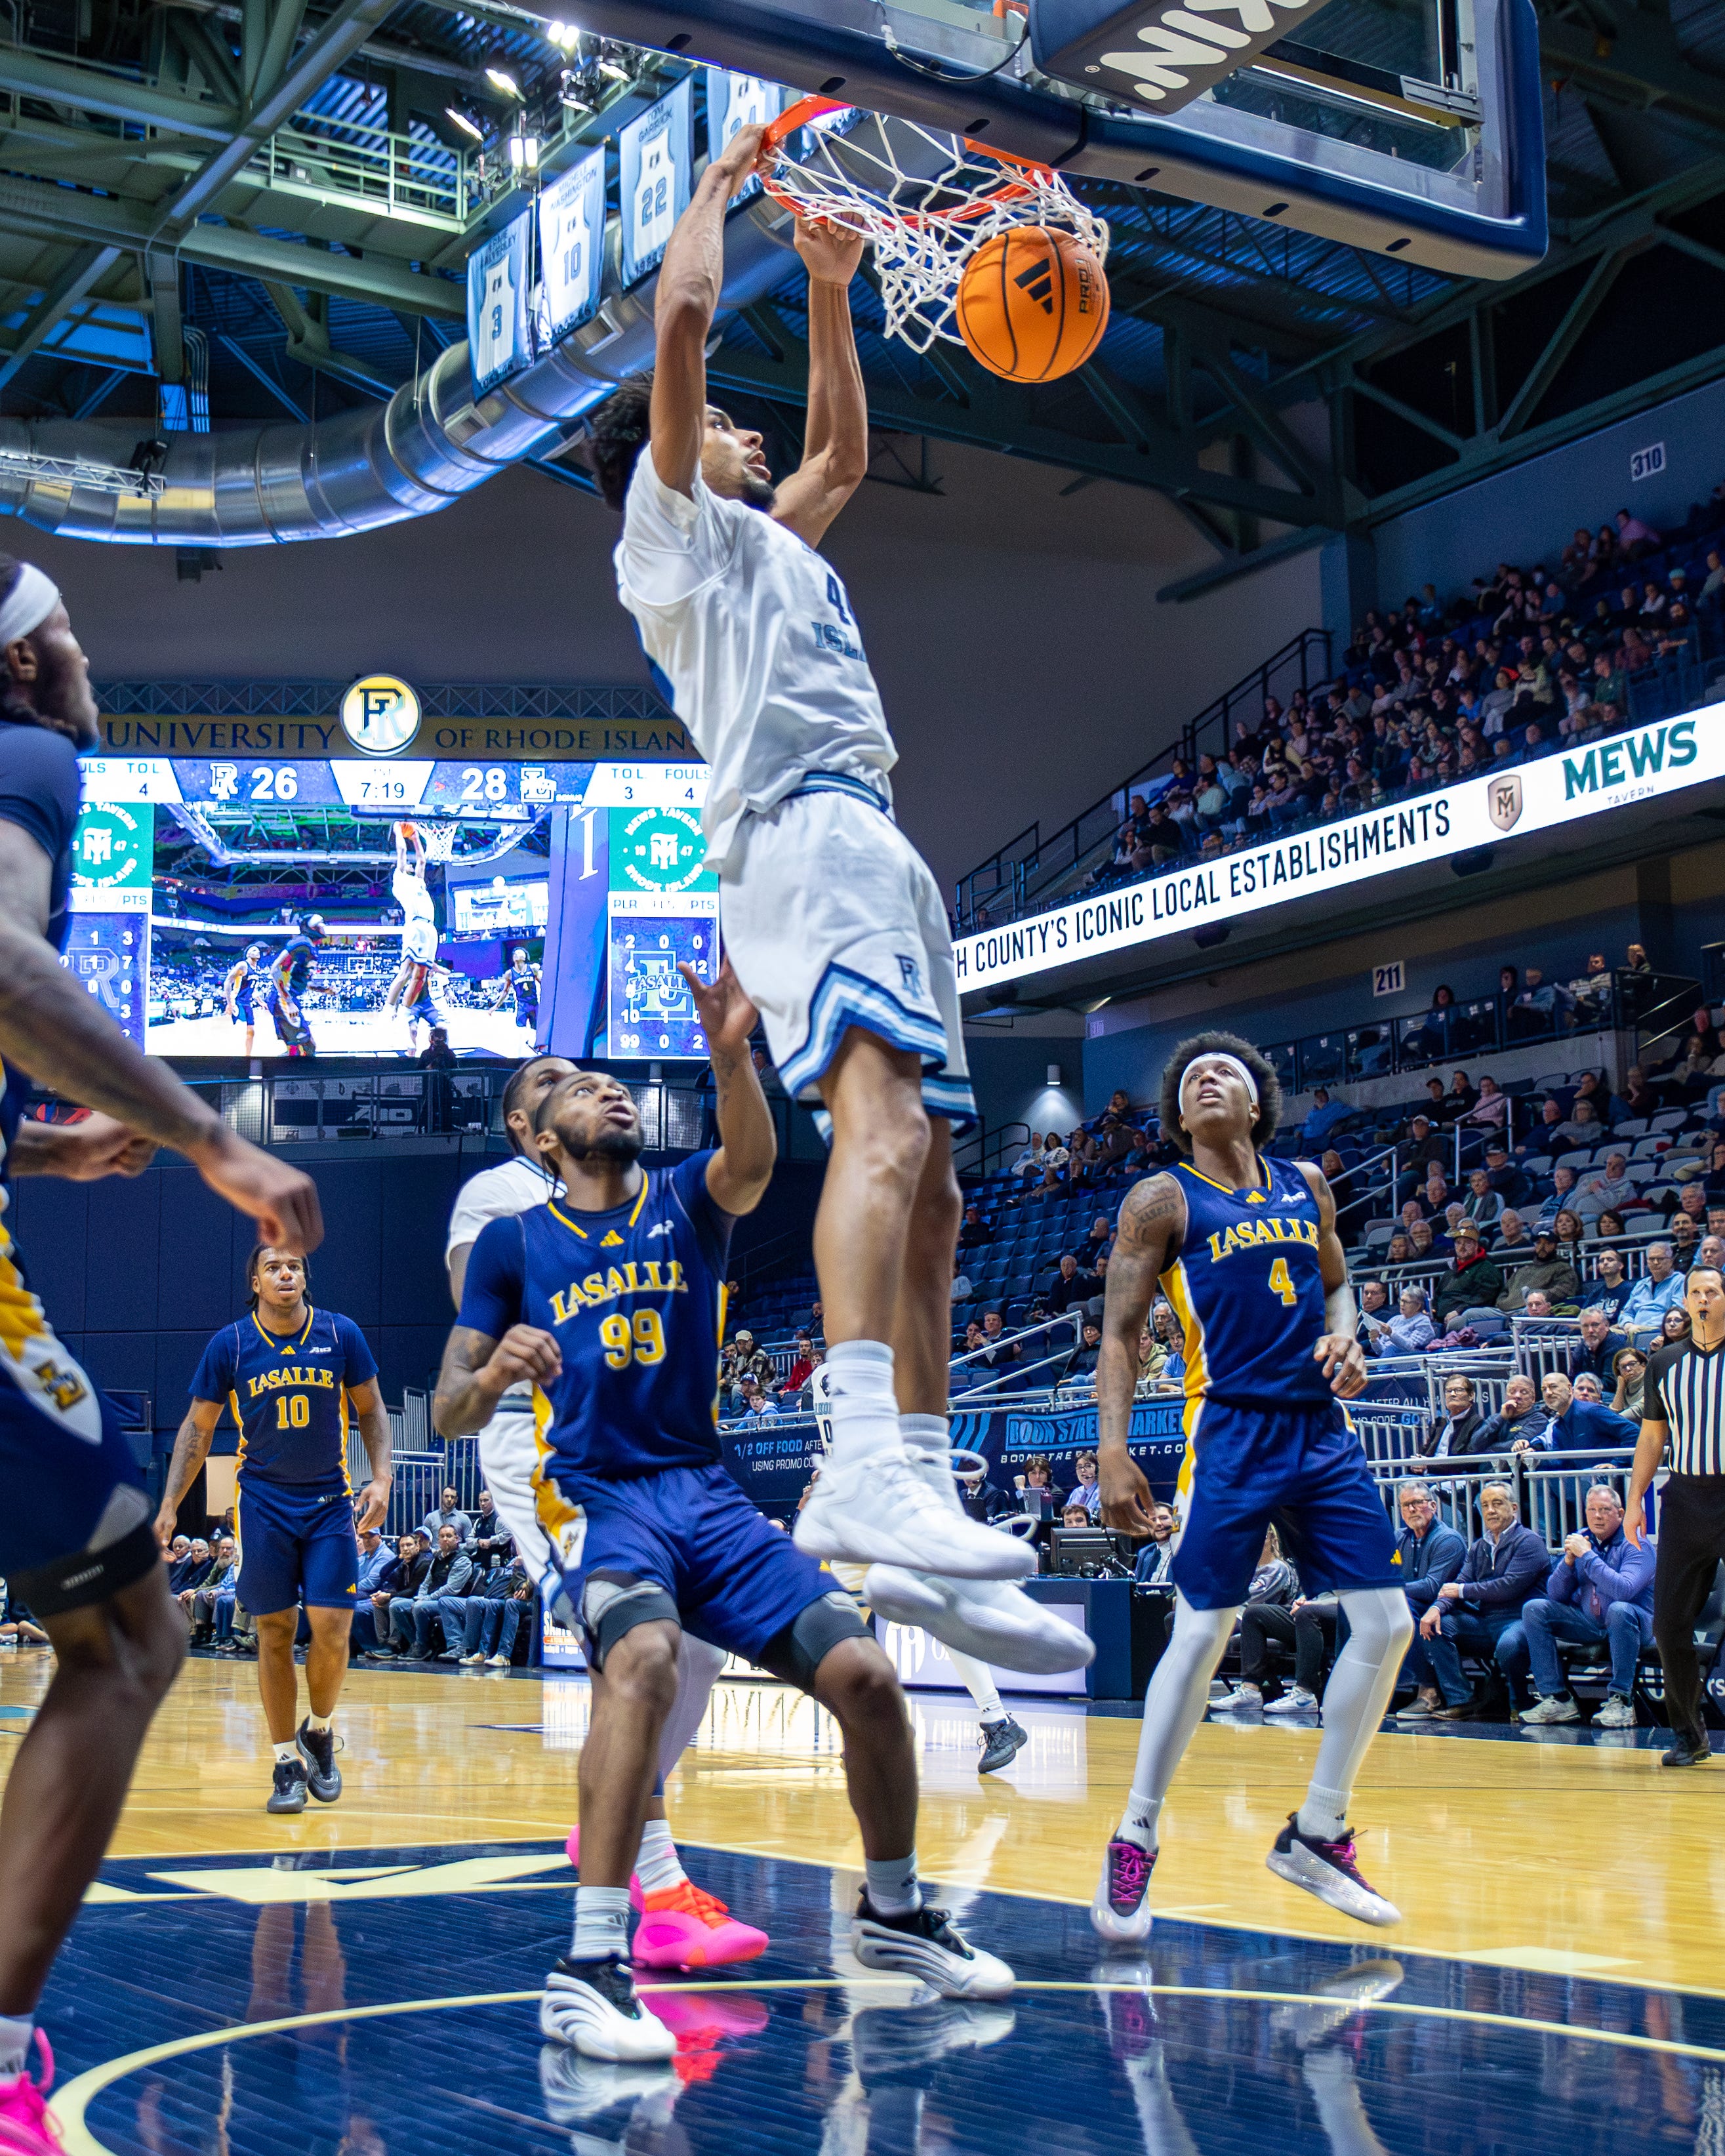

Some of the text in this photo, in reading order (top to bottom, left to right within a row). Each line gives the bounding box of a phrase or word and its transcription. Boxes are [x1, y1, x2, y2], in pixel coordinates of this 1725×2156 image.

[559, 164, 587, 192] MICHELE
[641, 176, 667, 228] 22
[564, 242, 582, 287] 10
[492, 304, 502, 341] 3
[1632, 447, 1662, 477] 310
[106, 722, 336, 750] UNIVERSITY
[435, 727, 686, 751] OF RHODE ISLAN
[1562, 721, 1697, 801] MEWS
[139, 783, 148, 796] 4
[251, 767, 298, 800] 26
[361, 783, 405, 798] 7:19
[460, 767, 507, 801] 28
[624, 786, 694, 800] 3 4
[1608, 786, 1654, 805] TAVERN
[975, 916, 1068, 972] COUNTY'S
[1076, 893, 1143, 943] ICONIC
[1153, 870, 1220, 921] LOCAL
[1230, 799, 1450, 897] ESTABLISHMENTS
[123, 895, 147, 905] PTS
[691, 901, 715, 909] PTS
[91, 931, 133, 946] 1 3
[625, 934, 703, 950] 2 0 0
[89, 955, 132, 969] 1 7
[624, 958, 708, 975] 4 1 12
[88, 979, 132, 994] 0 0
[629, 975, 691, 992] LASALL
[1376, 964, 1401, 992] 211
[659, 985, 669, 998] 0
[121, 1004, 131, 1019] 3
[620, 1009, 640, 1024] 10
[660, 1009, 668, 1024] 1
[620, 1034, 703, 1049] 99 0 2
[1206, 1217, 1319, 1263] LASALLE
[548, 1259, 689, 1326] LASALLE
[1268, 1257, 1297, 1307] 4
[599, 1307, 667, 1369] 99
[247, 1366, 334, 1398] LASALLE
[276, 1394, 310, 1429] 10
[1057, 1414, 1099, 1443] STRE
[734, 1438, 822, 1459] 1/2 OFF FOOD AFTE
[752, 1459, 775, 1472] USING
[776, 1457, 803, 1471] PROMO
